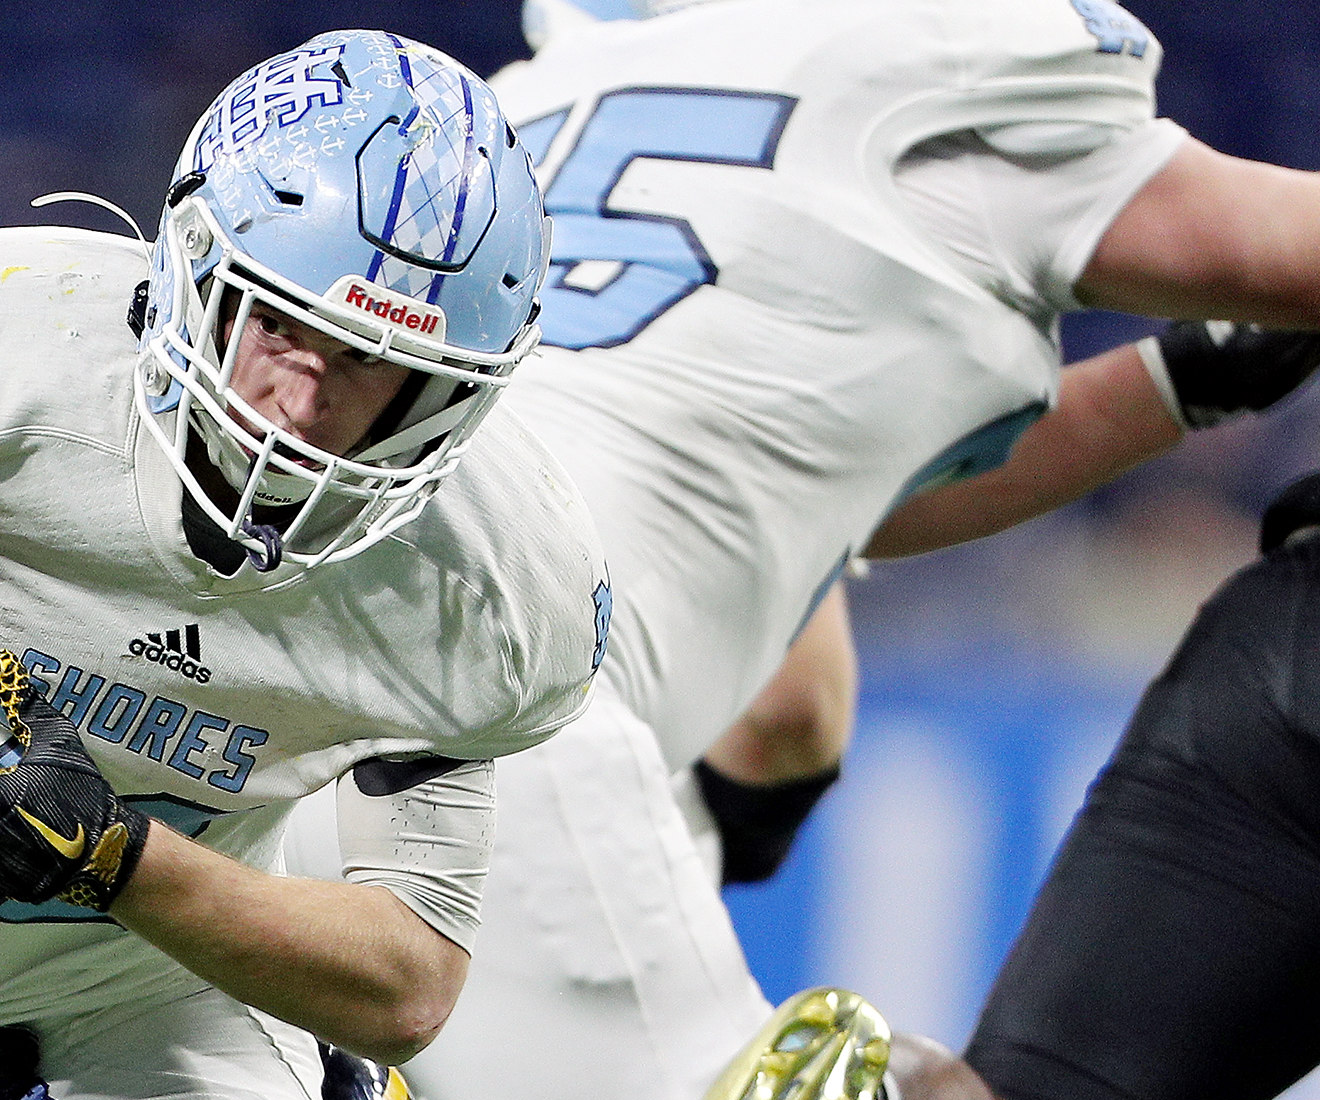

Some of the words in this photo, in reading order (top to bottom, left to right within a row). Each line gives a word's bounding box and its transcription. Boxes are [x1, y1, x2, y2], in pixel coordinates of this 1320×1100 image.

[516, 86, 799, 351] 5
[345, 284, 440, 334] Riddell
[129, 638, 212, 683] adidas
[20, 648, 270, 793] SHORES
